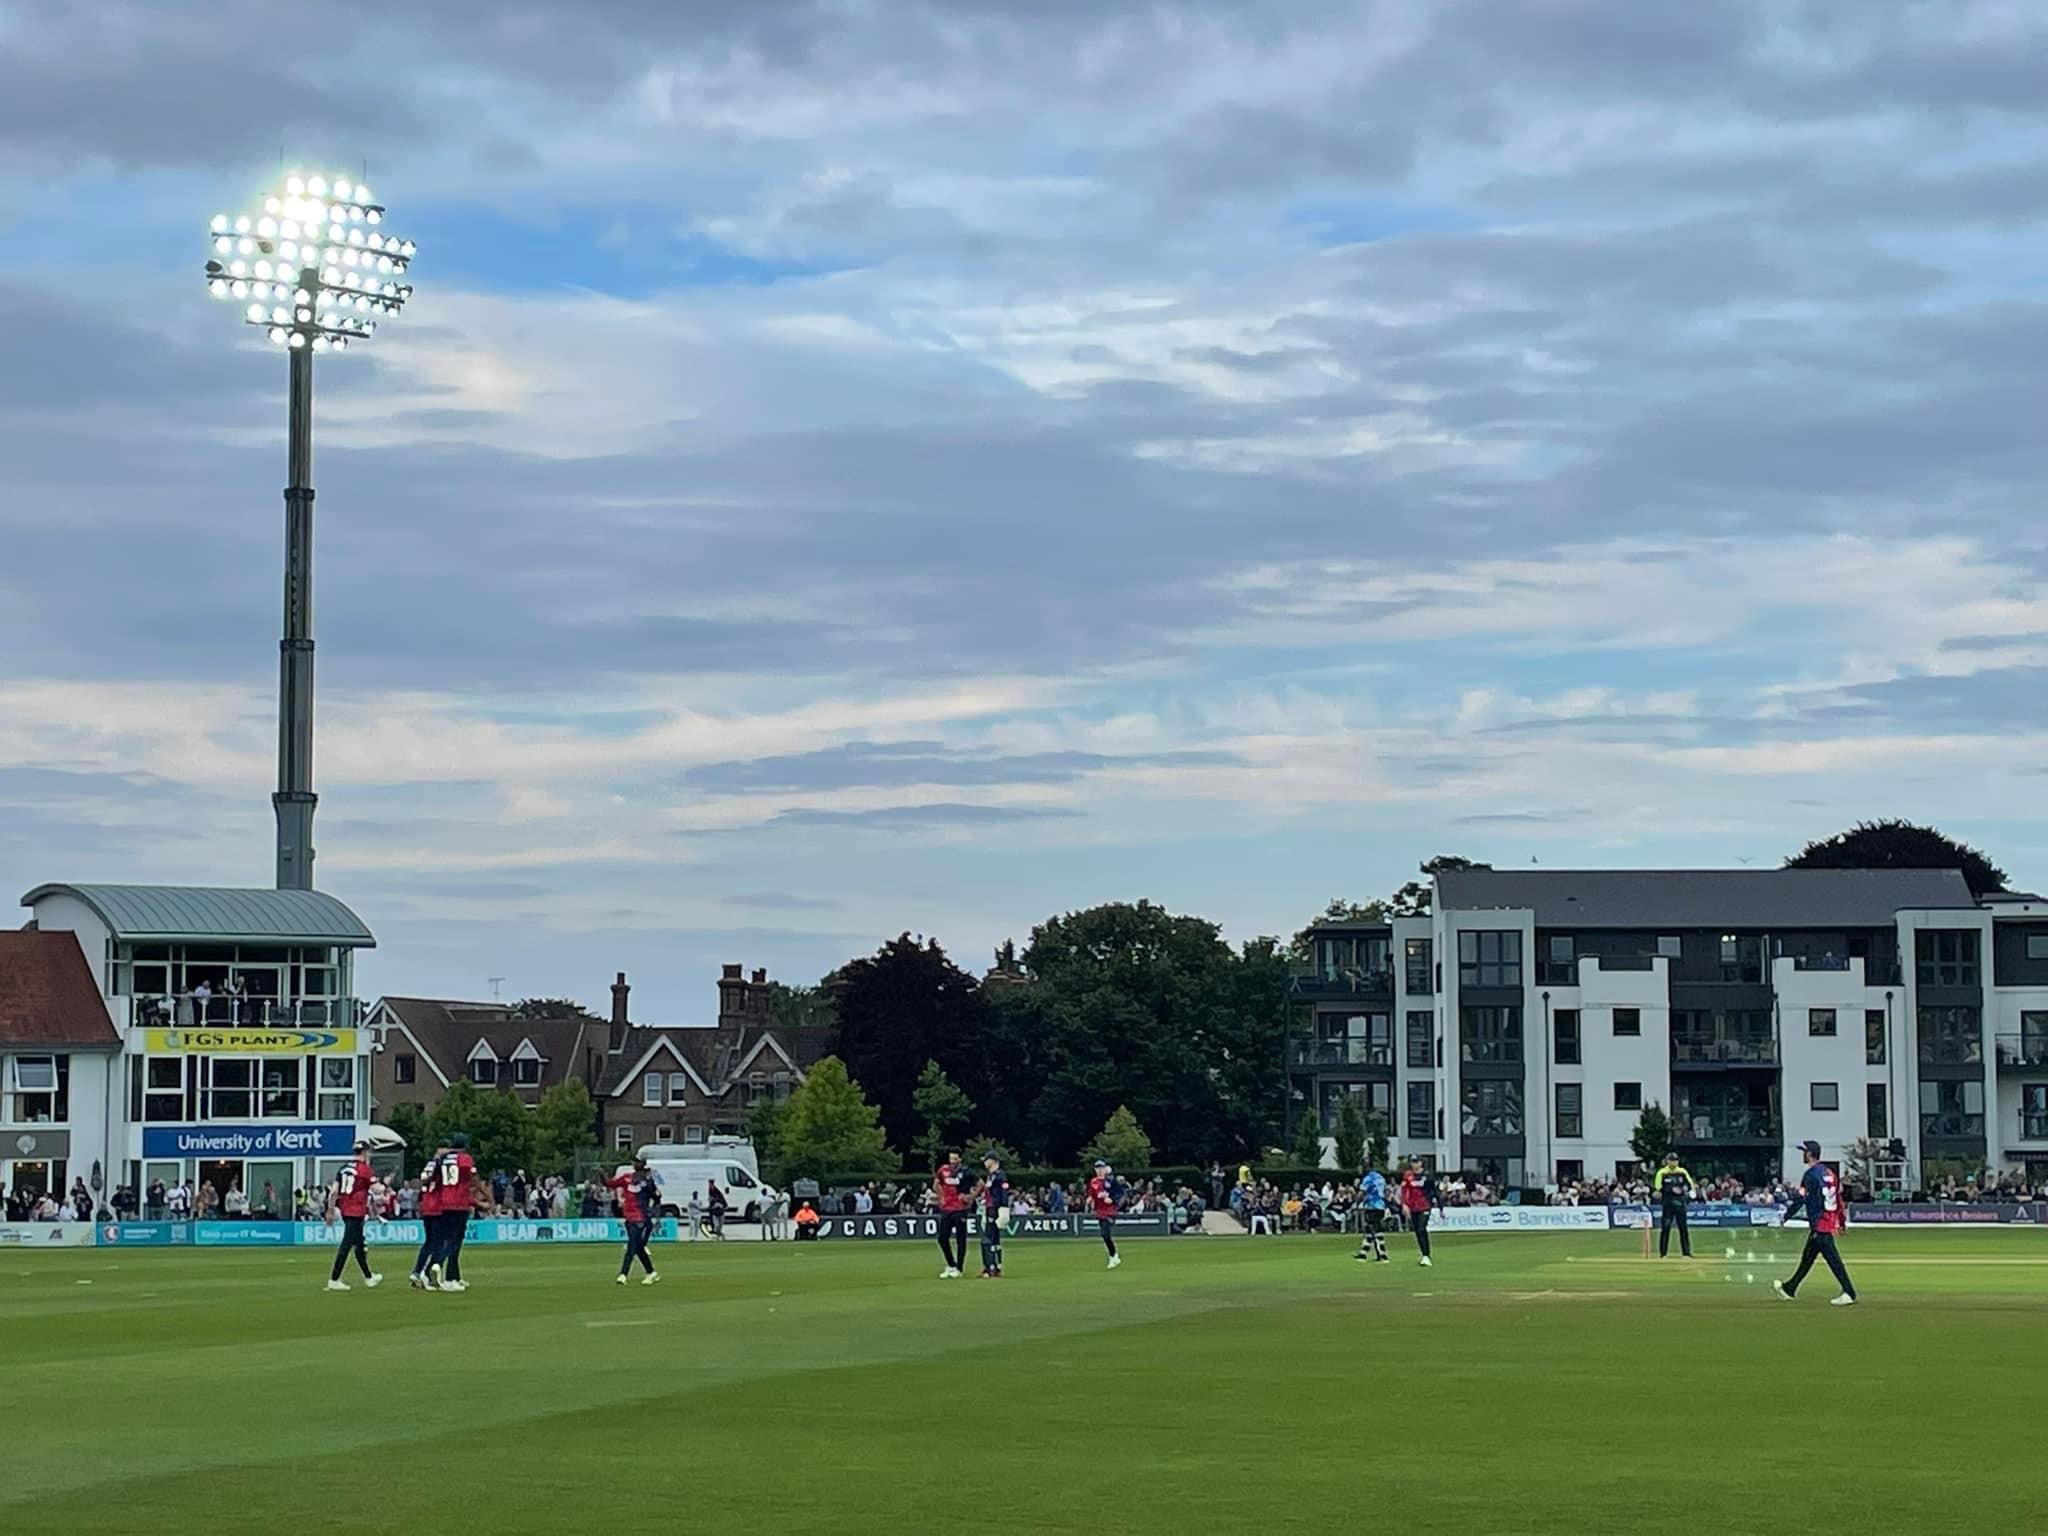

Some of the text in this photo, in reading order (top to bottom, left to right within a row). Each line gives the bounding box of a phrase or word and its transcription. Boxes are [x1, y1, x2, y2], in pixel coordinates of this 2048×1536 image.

[184, 1033, 290, 1045] FGS PLANT
[178, 1129, 322, 1154] University of Kent
[843, 1218, 977, 1236] CASTOE
[1024, 1219, 1069, 1231] AZETS
[1518, 1211, 1582, 1226] Barretts
[364, 1224, 419, 1241] SLAND
[497, 1223, 537, 1240] BEAR
[552, 1222, 609, 1239] ISLAND
